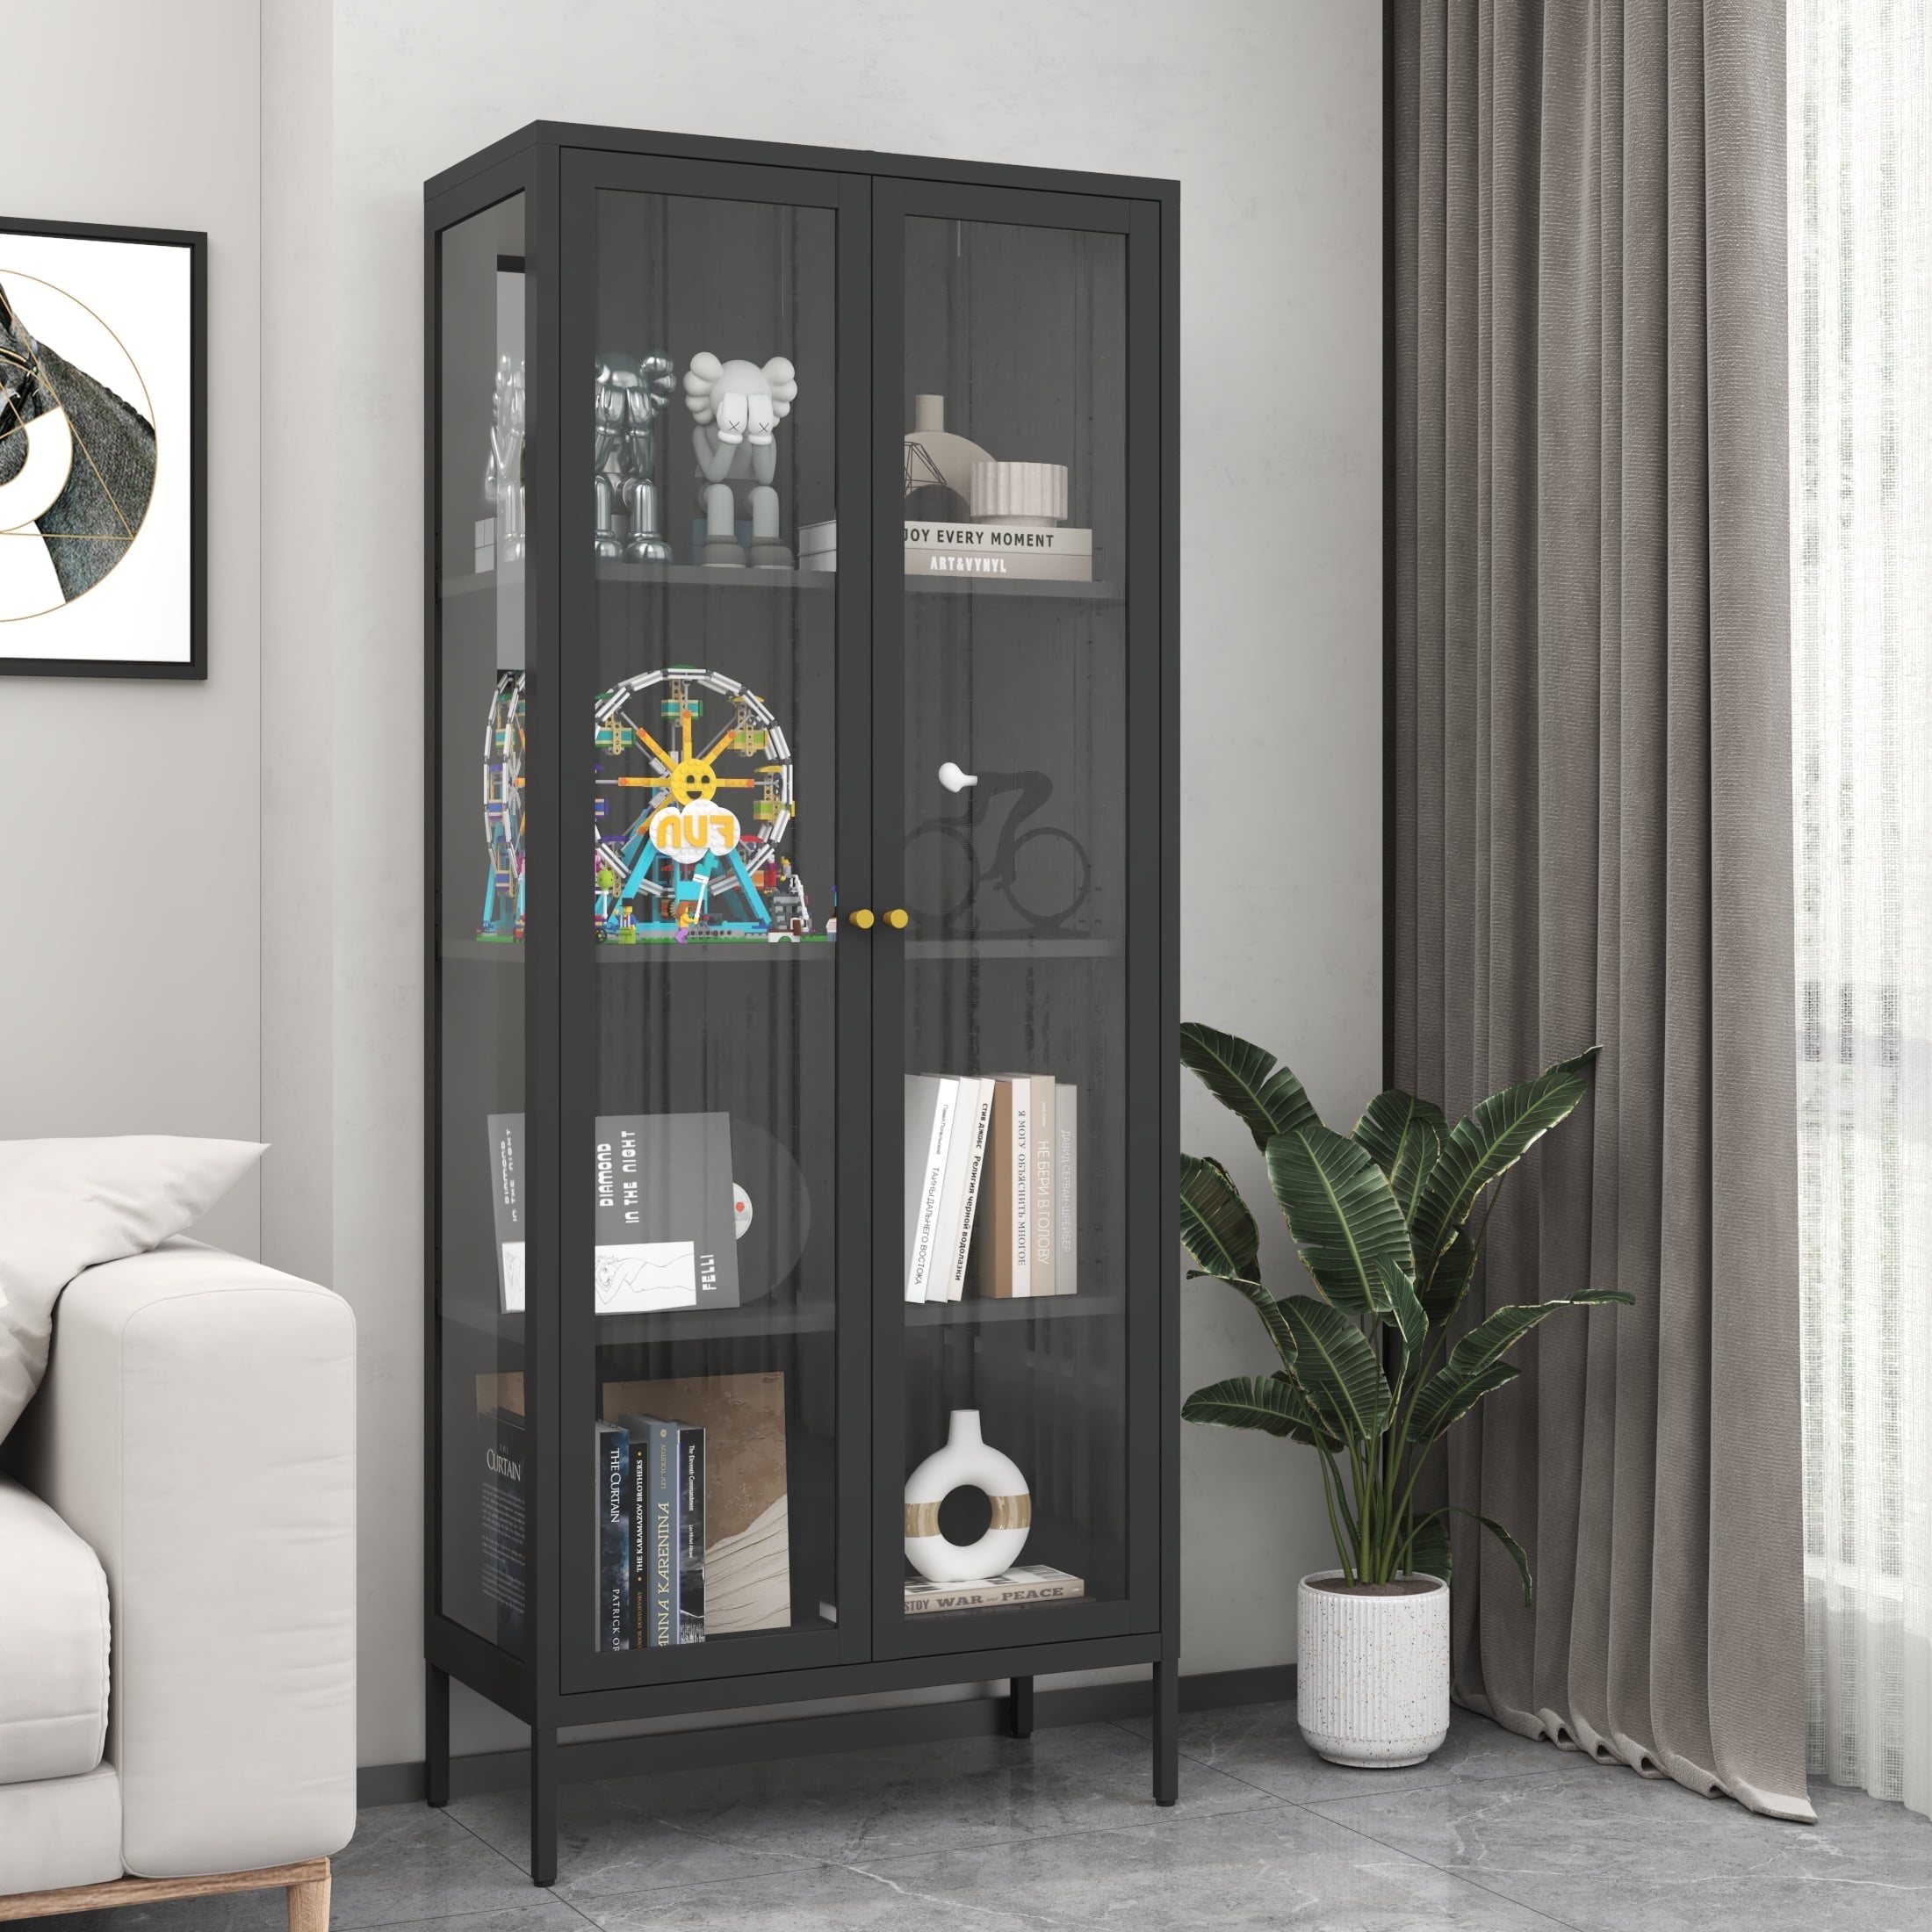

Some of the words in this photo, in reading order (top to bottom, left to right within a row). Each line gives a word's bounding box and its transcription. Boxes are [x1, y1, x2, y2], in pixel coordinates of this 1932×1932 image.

[905, 529, 930, 543] JOY
[937, 530, 984, 544] EVERY
[991, 532, 1054, 547] MOMENT
[930, 556, 1006, 573] ART&VYNYL
[621, 1130, 637, 1172] NIGHT
[1037, 1141, 1049, 1158] НЕ
[1060, 1129, 1071, 1163] ДАВИД
[597, 1143, 614, 1207] DIAMOND
[969, 1156, 981, 1194] Религия
[1037, 1161, 1049, 1195] БЕРИ
[623, 1181, 638, 1206] THE
[1037, 1200, 1049, 1208] В
[921, 1197, 934, 1244] ДАЛЬНЕГО
[963, 1195, 974, 1229] черной
[1037, 1211, 1050, 1265] ГОЛОВУ
[700, 1254, 717, 1291] FELLI
[914, 1244, 927, 1285] ВОСТОКА
[955, 1231, 969, 1281] водолазки
[610, 1447, 620, 1471] THE
[610, 1473, 622, 1523] CURTAIN
[658, 1502, 669, 1594] KARENINA
[936, 1595, 983, 1607] WAR
[1002, 1588, 1063, 1601] PEACE
